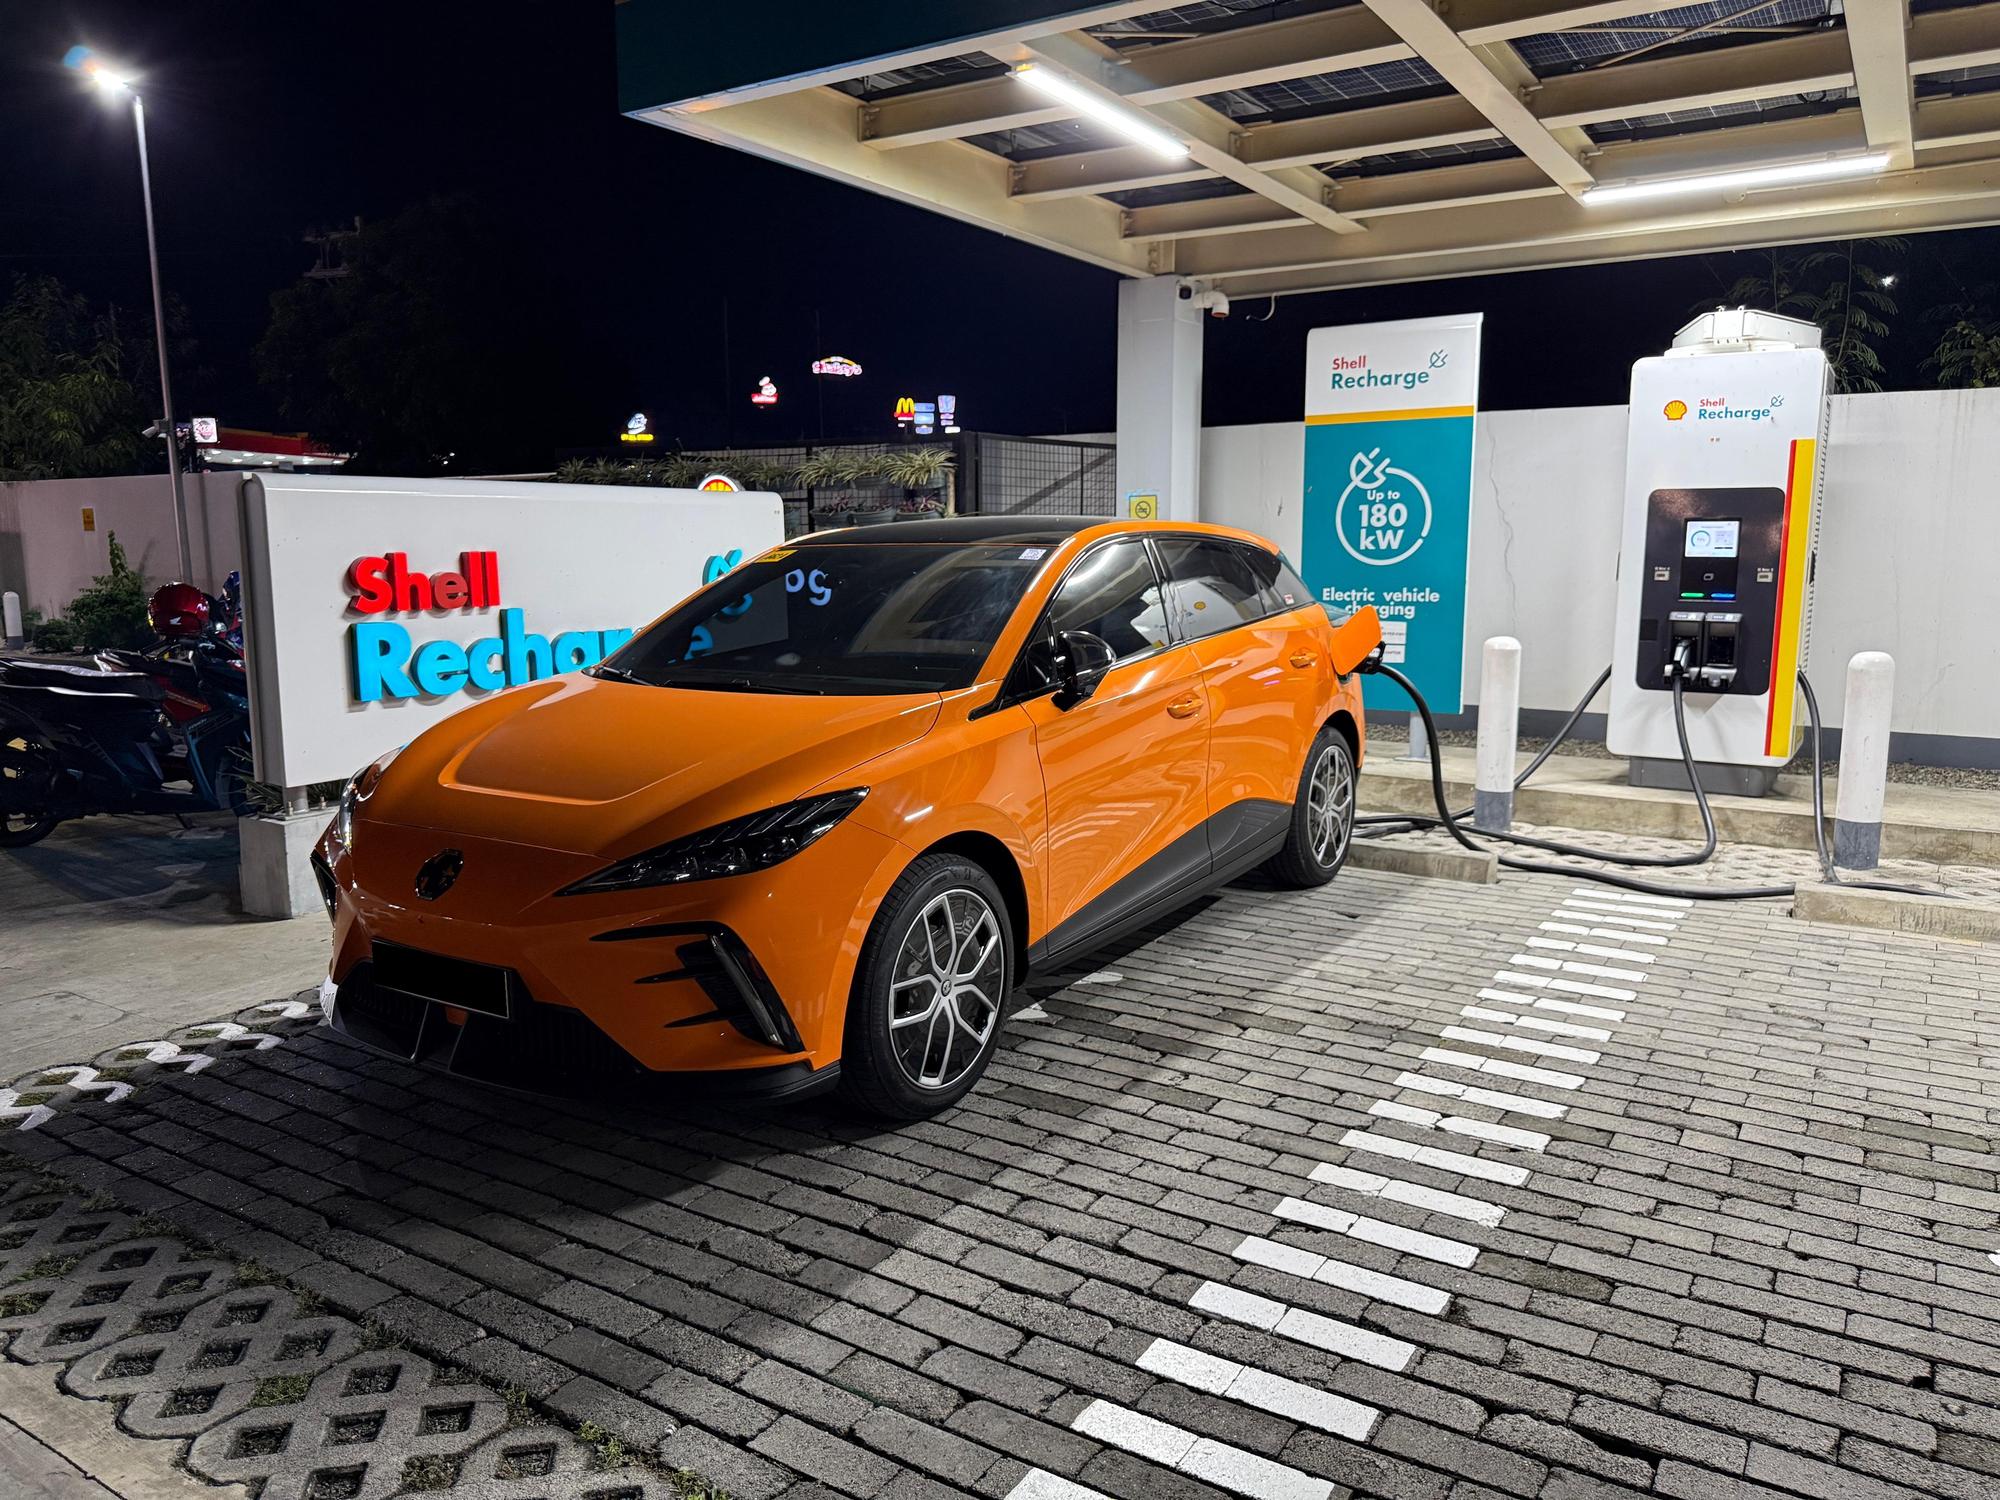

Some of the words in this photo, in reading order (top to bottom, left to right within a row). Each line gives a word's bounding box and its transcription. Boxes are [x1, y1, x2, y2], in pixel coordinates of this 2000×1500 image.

[1332, 355, 1366, 371] Shell
[1331, 369, 1430, 390] Recharge
[1700, 397, 1725, 407] Shell
[1698, 406, 1771, 421] Recharge
[1367, 490, 1385, 503] Up
[1387, 490, 1401, 500] to
[1359, 503, 1408, 528] 180
[1360, 528, 1404, 551] kW
[348, 551, 500, 614] Shell
[1322, 587, 1376, 602] Electric
[1382, 587, 1441, 603] vehicle
[1345, 600, 1416, 620] chging
